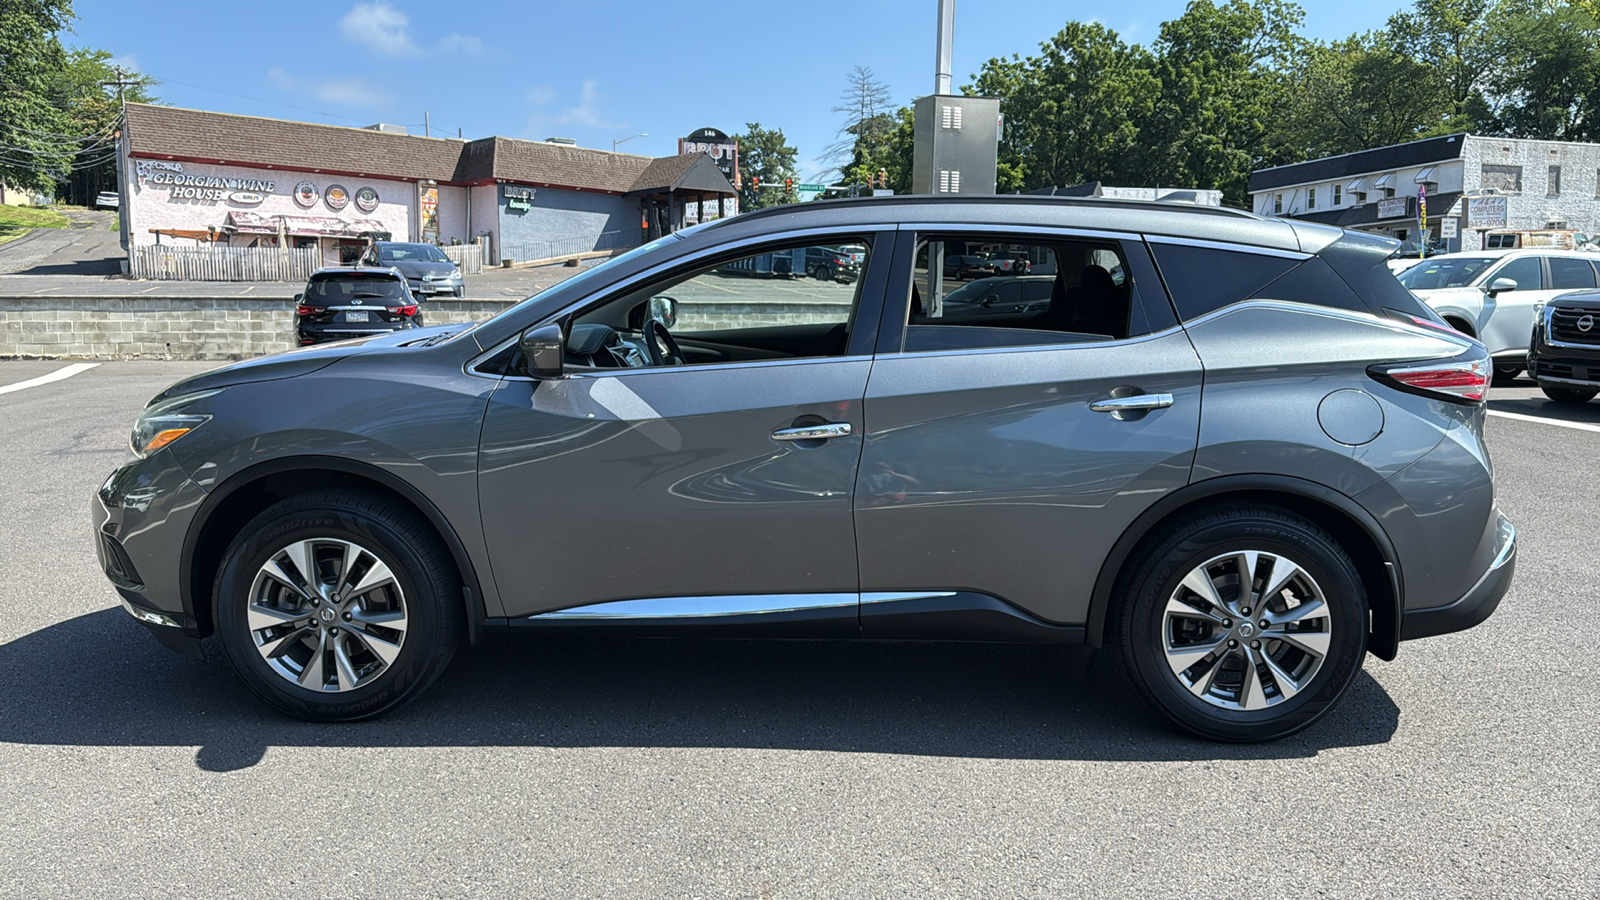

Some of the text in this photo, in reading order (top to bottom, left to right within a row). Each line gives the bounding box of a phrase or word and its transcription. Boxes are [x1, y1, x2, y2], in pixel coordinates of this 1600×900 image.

[154, 173, 276, 192] GEORGIAN WINE
[172, 187, 222, 200] HOUSE
[504, 186, 536, 200] BRUT
[1470, 204, 1504, 213] COMPUTERS
[1468, 218, 1506, 228] 942-9700
